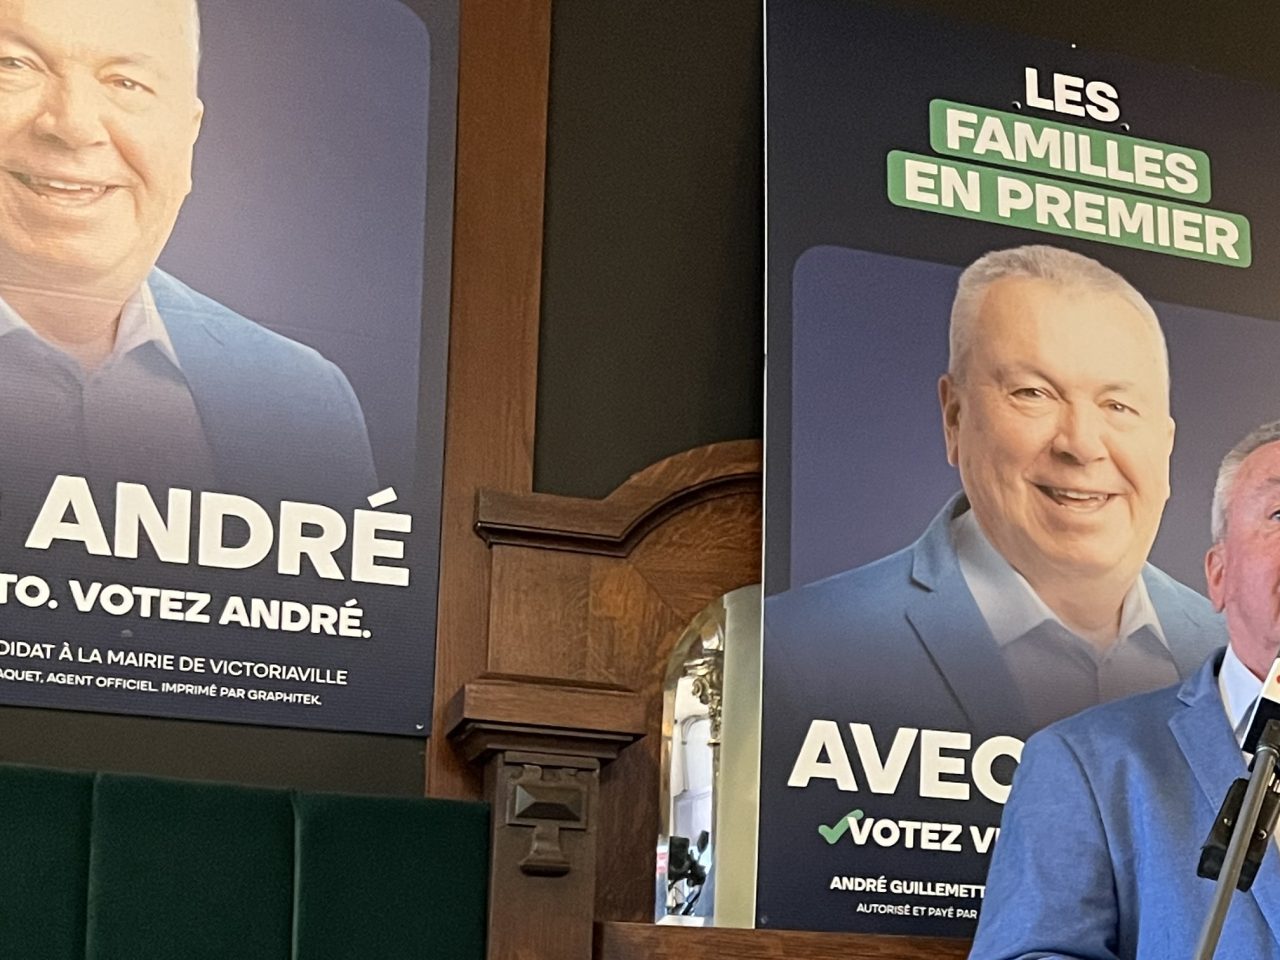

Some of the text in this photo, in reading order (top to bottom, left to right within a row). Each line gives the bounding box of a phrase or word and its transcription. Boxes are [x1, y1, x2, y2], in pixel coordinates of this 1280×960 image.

[1025, 67, 1120, 122] LES
[946, 108, 1198, 194] FAMILLES
[904, 159, 1240, 260] EN PREMIER
[24, 474, 412, 587] ANDRÉ
[68, 580, 211, 624] VOTEZ
[219, 596, 372, 639] ANDRÉ.
[47, 673, 94, 686] AGENT
[162, 682, 217, 697] IMPRIMÉ
[220, 687, 245, 699] PAR
[59, 642, 73, 661] À
[78, 647, 102, 664] LA
[107, 650, 175, 670] MAIRIE
[179, 656, 206, 673] DE
[209, 659, 348, 685] VICTORIAVILLE
[787, 719, 1025, 804] AVEC
[847, 816, 963, 852] VOTEZ
[830, 876, 986, 898] ANDRÉ GUILLEMETT
[856, 902, 977, 919] AUTORISÉ ET PAYÉ PAR
